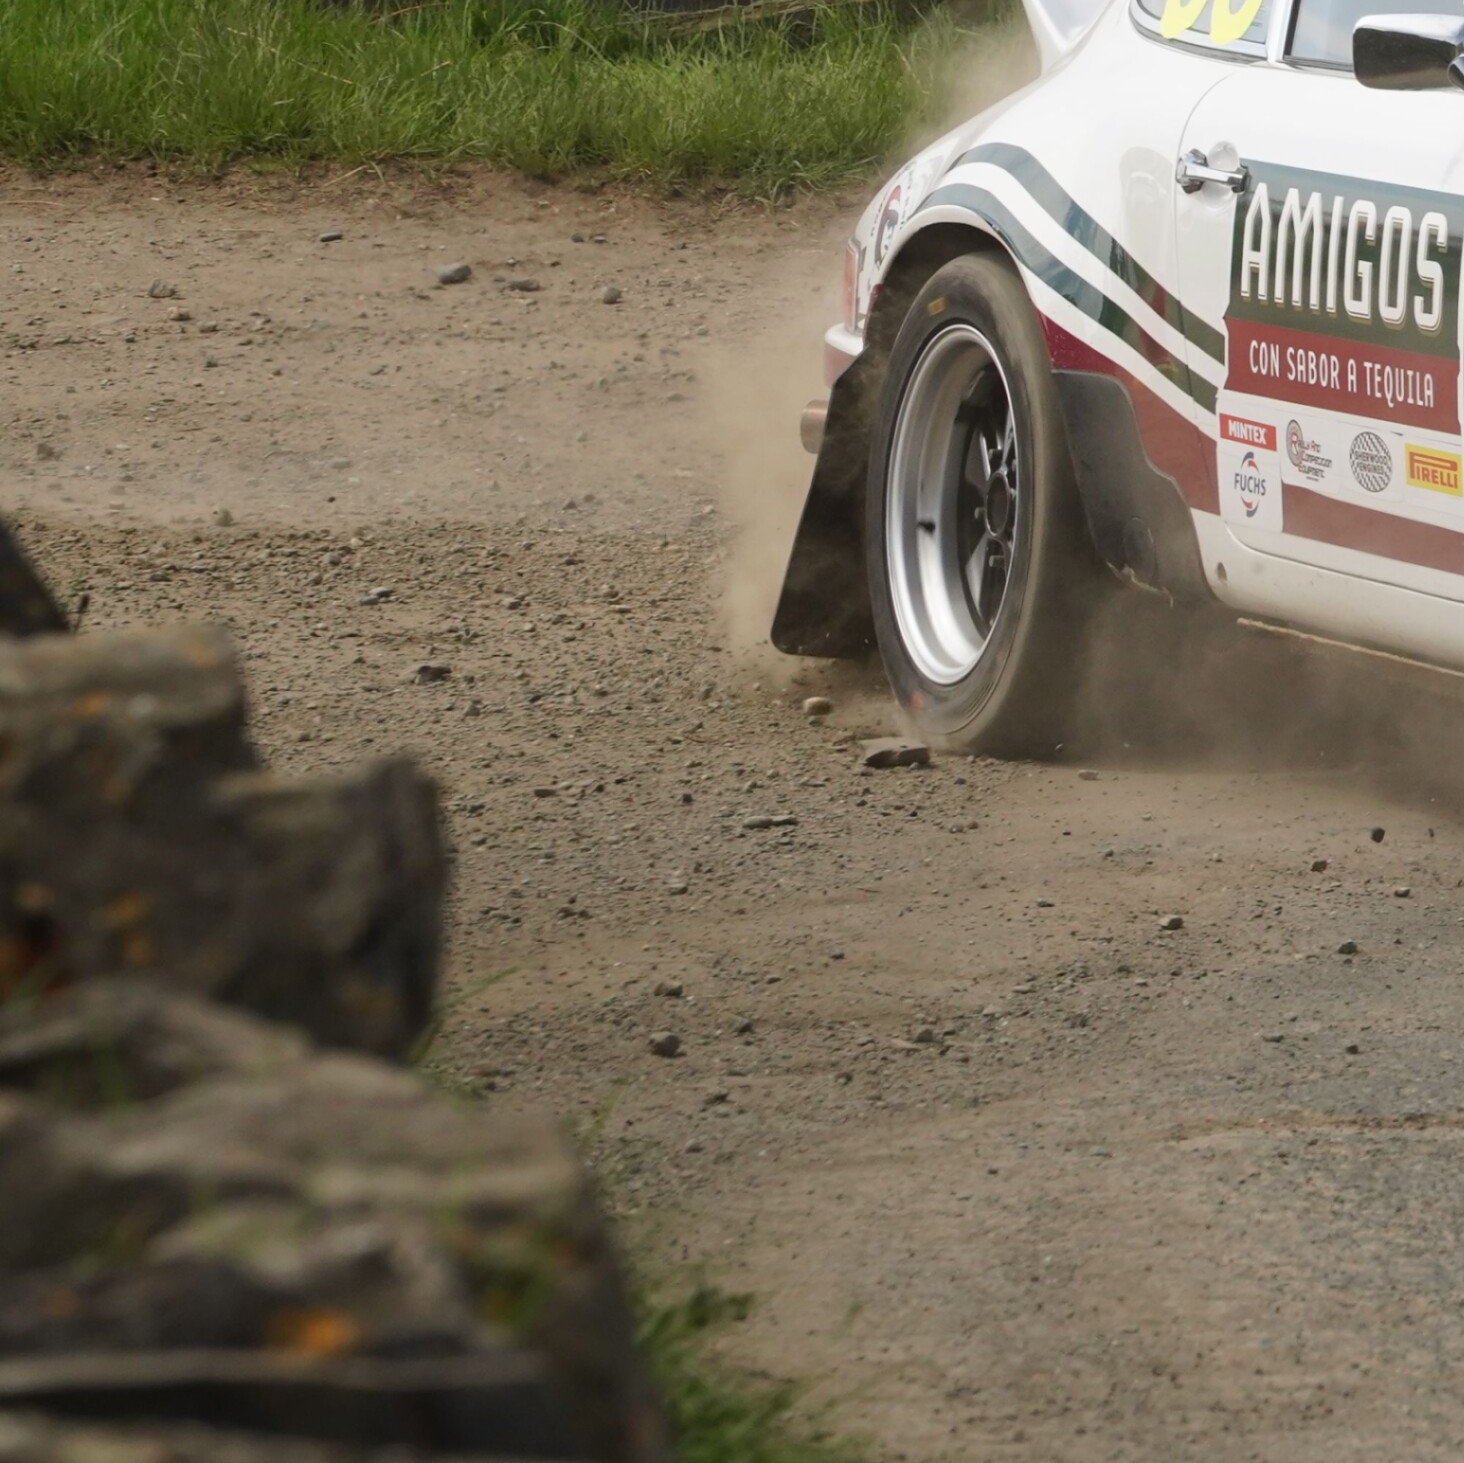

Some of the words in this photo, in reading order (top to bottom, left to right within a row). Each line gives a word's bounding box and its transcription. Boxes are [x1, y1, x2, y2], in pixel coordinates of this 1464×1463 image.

[1240, 182, 1448, 334] AMIGOS
[1249, 339, 1282, 378] CON
[1286, 346, 1340, 392] SABOR
[1347, 357, 1358, 393] A
[1363, 361, 1434, 409] TEQUILA
[1228, 420, 1267, 445] MINTEX
[1234, 473, 1266, 496] FUCHS
[1409, 451, 1459, 489] PIRELLI
